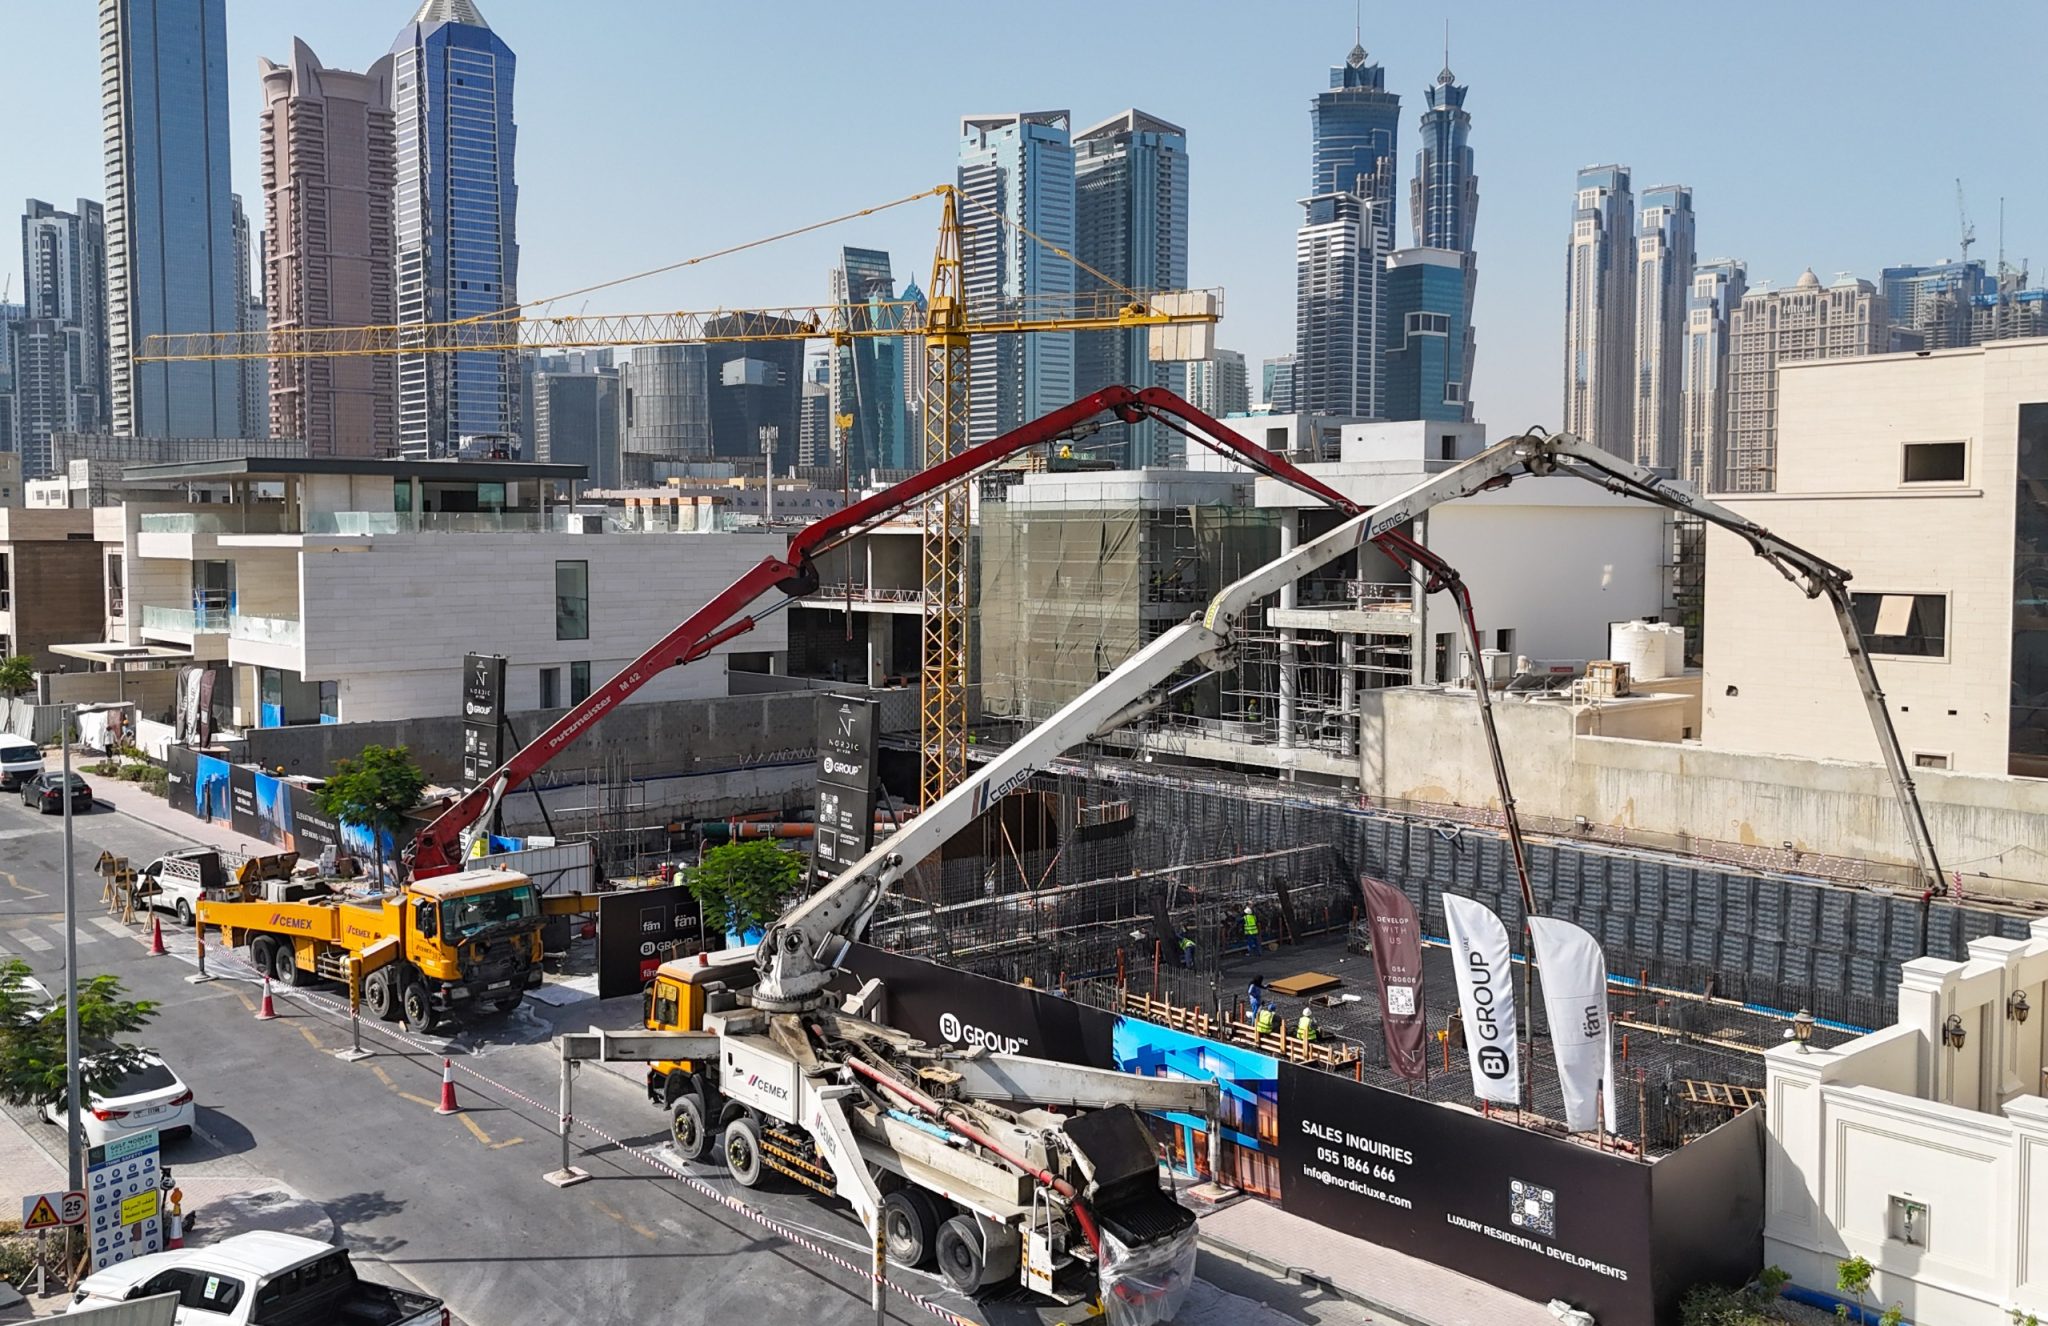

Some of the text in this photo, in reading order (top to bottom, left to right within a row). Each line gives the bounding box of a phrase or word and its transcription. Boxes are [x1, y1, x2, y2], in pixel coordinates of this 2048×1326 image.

[1783, 304, 1812, 314] Hilton
[1371, 508, 1410, 536] CEMEX
[549, 672, 642, 748] Putzmeister M 42
[833, 762, 859, 776] GROUP
[990, 763, 1036, 802] CEMEX
[279, 916, 312, 930] CEMEX
[643, 921, 660, 931] fäm
[674, 915, 696, 928] fäm
[1376, 915, 1409, 925] DEVELOP
[1381, 926, 1408, 935] WITH
[351, 927, 371, 939] CEMEX
[1389, 937, 1403, 946] US
[1391, 965, 1407, 974] 054
[1469, 951, 1499, 1042] GROUP
[1583, 1004, 1602, 1040] fäm
[942, 1015, 959, 1040] BI
[963, 1024, 1020, 1056] GROUP
[1482, 1049, 1507, 1076] BI
[757, 1080, 789, 1101] CEMEX
[819, 1120, 837, 1159] CEMEX
[1301, 1120, 1413, 1166] SALES INQUIRIES
[1317, 1146, 1396, 1183] 055 1866 666
[1303, 1163, 1412, 1210] info@nordicluxe.com
[64, 1200, 81, 1213] 25
[1447, 1213, 1628, 1282] LUXURY RESIDENTIAL DEVELOPMENTS
